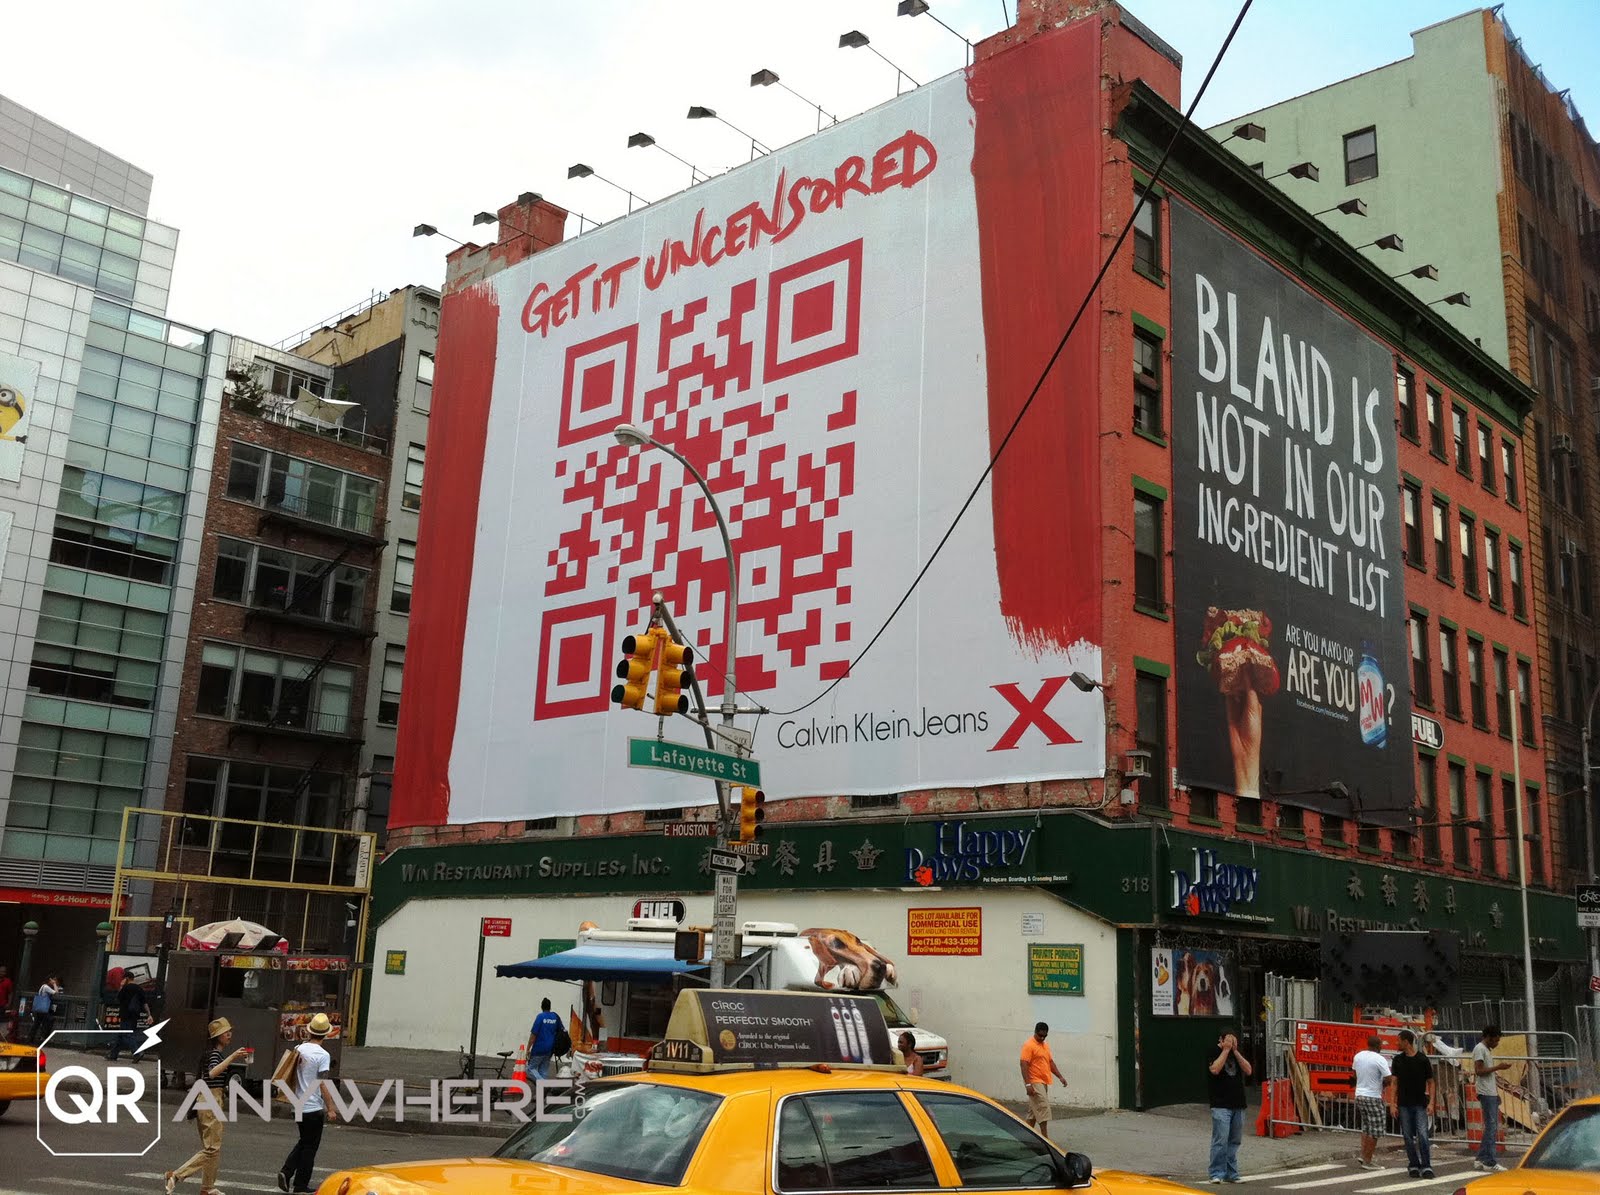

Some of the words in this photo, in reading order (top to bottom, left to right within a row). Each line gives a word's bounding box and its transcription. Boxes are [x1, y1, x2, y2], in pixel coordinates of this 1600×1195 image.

[521, 263, 597, 338] GET
[591, 256, 640, 316] IT
[644, 130, 937, 291] UNCENSORED
[1195, 273, 1335, 446] BLAND
[1352, 376, 1383, 474] IS
[1196, 391, 1270, 498] NOT
[1284, 437, 1315, 520] IN
[1326, 461, 1386, 560] OUR
[1198, 482, 1339, 596] INGREDIENT
[1346, 550, 1390, 618] LIST
[1285, 623, 1300, 647] ARE
[1302, 630, 1319, 653] YOU
[1321, 637, 1342, 661] MAYO
[1343, 646, 1354, 667] OR
[1286, 647, 1321, 703] ARE
[1323, 660, 1356, 712] YOU
[777, 715, 848, 749] Calvin
[854, 709, 911, 742] Klein
[913, 706, 989, 738] Jeans
[1411, 715, 1438, 746] FUEL
[651, 745, 725, 773] Lafayette
[732, 762, 747, 779] St
[664, 824, 670, 836] E
[672, 824, 709, 836] HOUSTON
[761, 843, 769, 856] ST
[934, 821, 1036, 868] Happy
[713, 855, 725, 865] ONE
[726, 857, 736, 867] WAY
[904, 847, 981, 882] Paws
[434, 861, 533, 881] RESTAURANT
[1191, 847, 1261, 902] Happy
[722, 876, 734, 885] WAIT
[1121, 877, 1149, 893] 318
[722, 886, 733, 894] FOR
[53, 895, 87, 904] 24-Hour
[719, 894, 736, 904] GREEN
[640, 902, 677, 920] FUEL
[719, 904, 734, 913] LIGHT
[924, 912, 935, 920] LOT
[911, 920, 961, 928] COMMERCIAL
[962, 920, 978, 928] USE
[711, 1000, 745, 1011] CÎROC
[715, 1015, 769, 1026] PERFECTLY
[771, 1016, 812, 1027] SMOOTH
[737, 1032, 758, 1040] Awarded
[758, 1032, 764, 1040] to
[764, 1032, 772, 1040] the
[772, 1032, 790, 1041] original
[666, 1042, 689, 1059] 1V11
